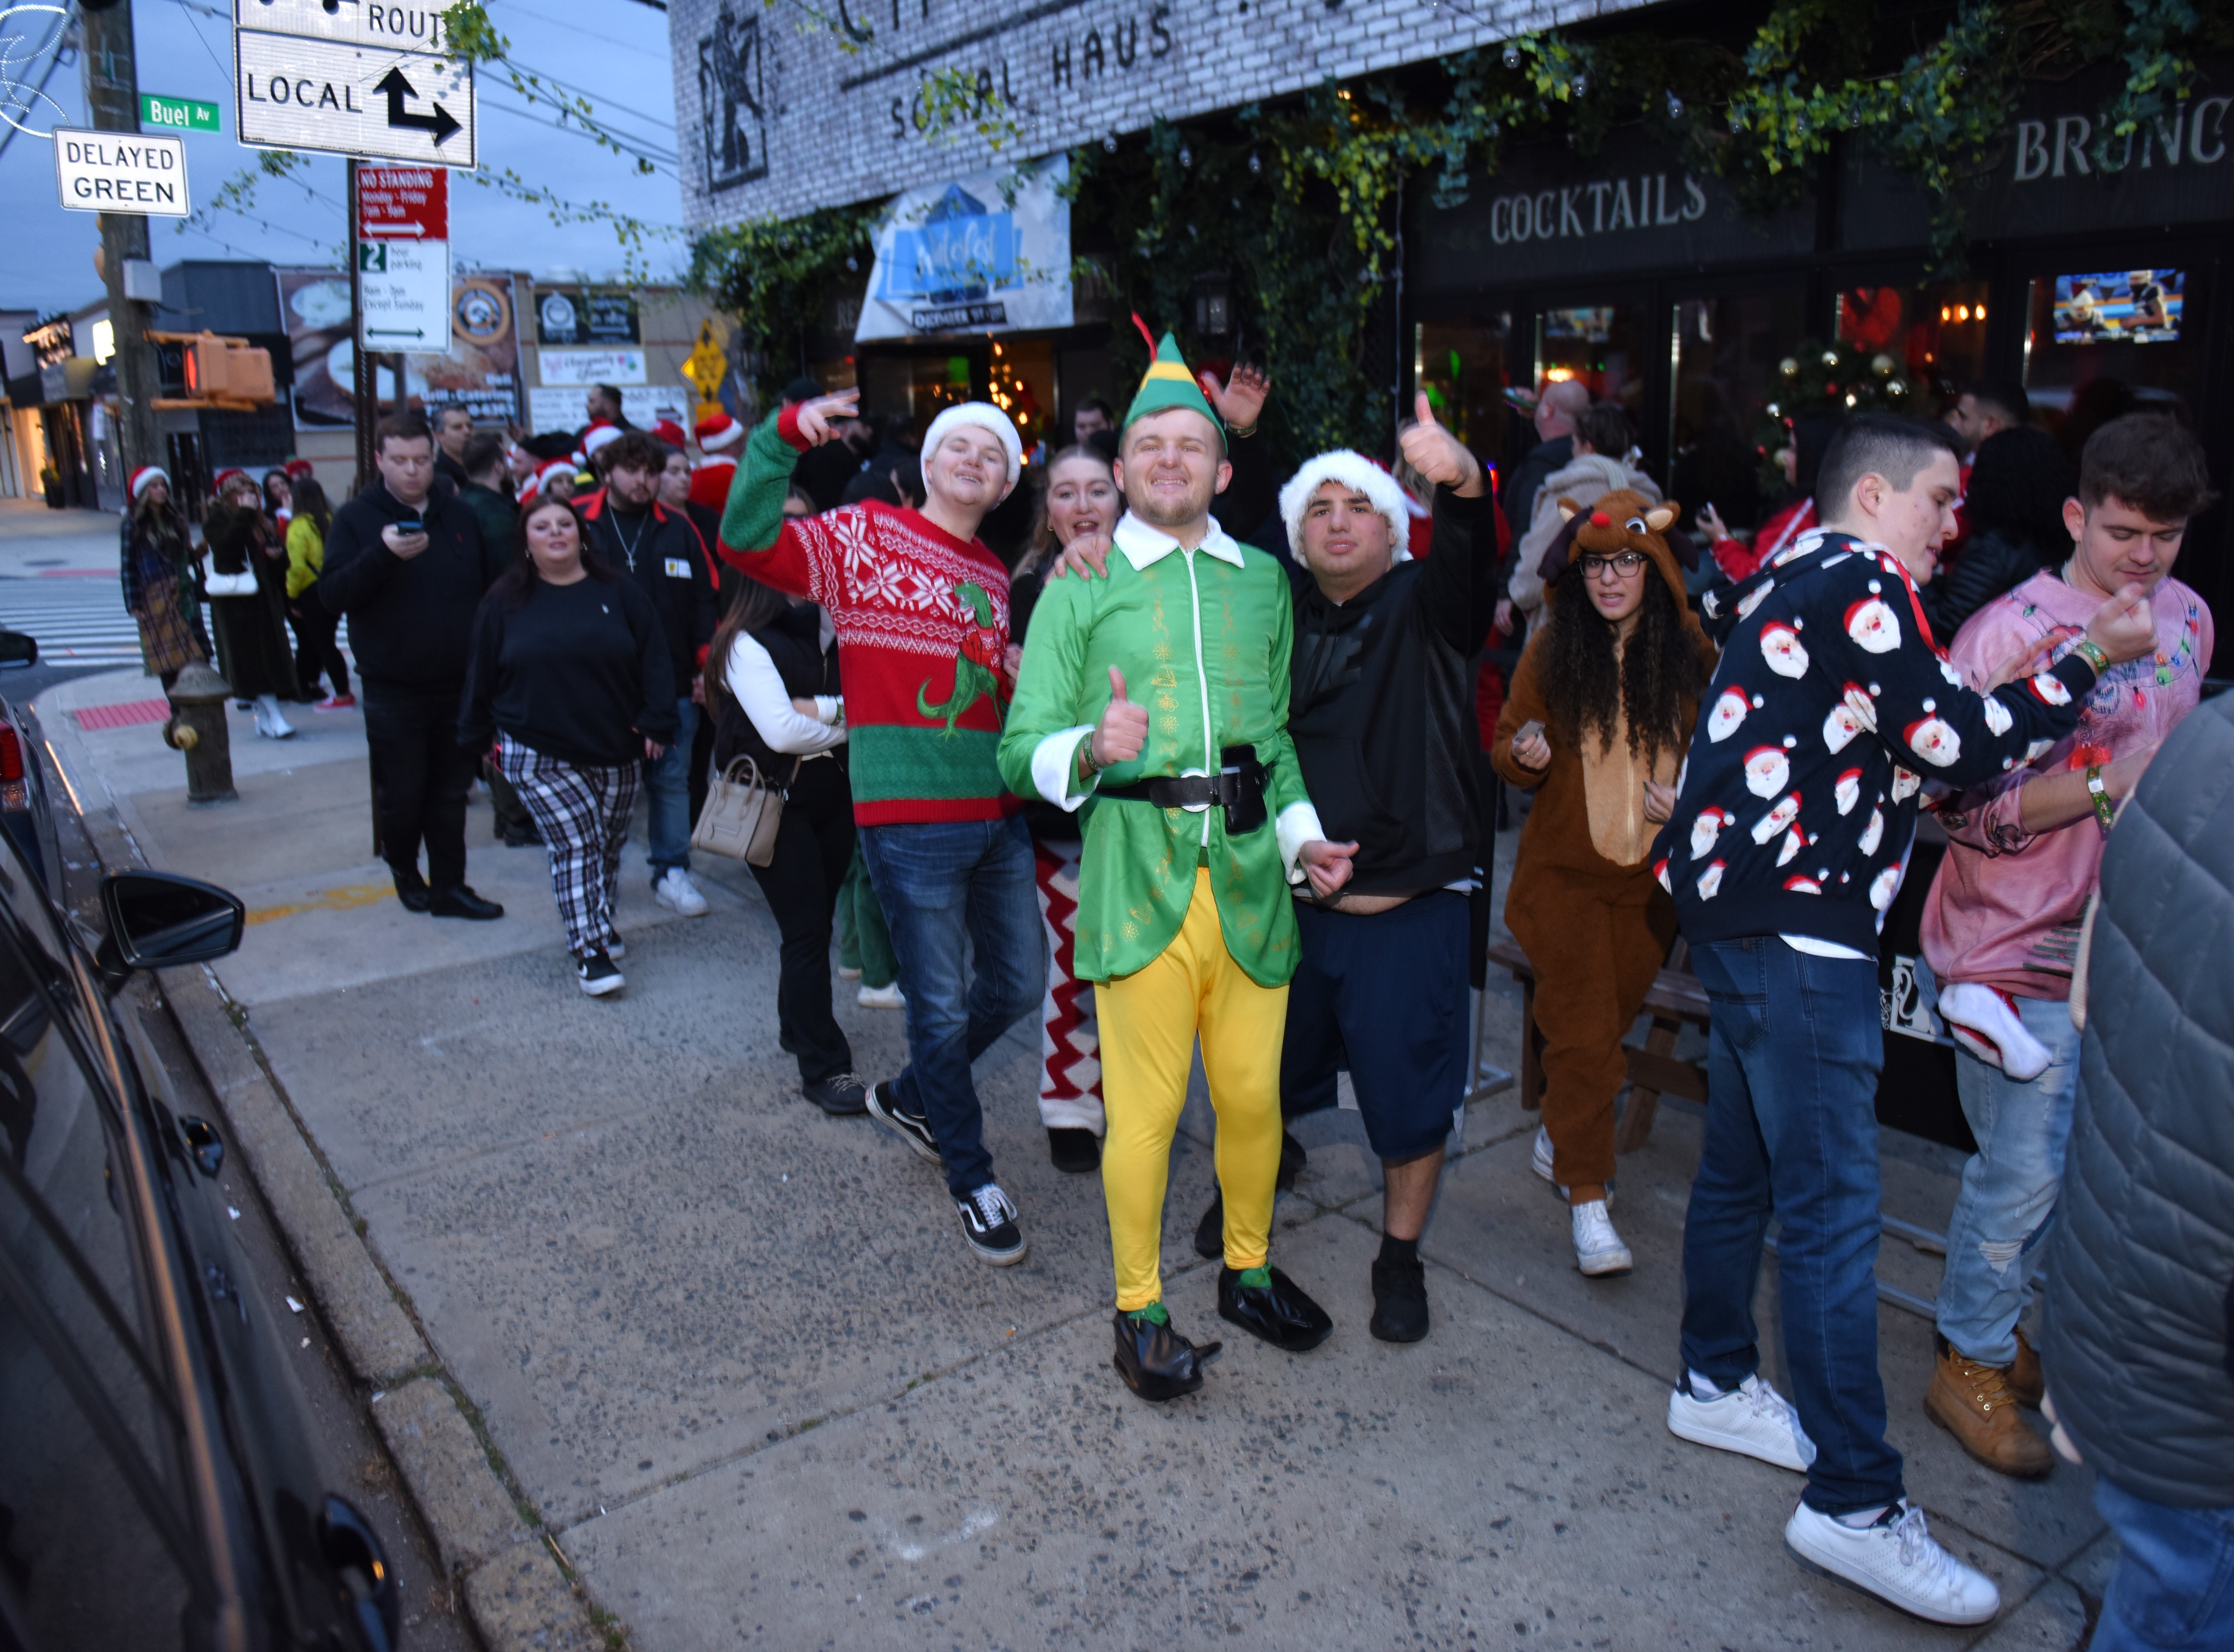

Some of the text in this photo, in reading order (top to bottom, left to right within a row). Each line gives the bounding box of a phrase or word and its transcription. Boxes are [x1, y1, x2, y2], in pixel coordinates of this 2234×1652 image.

[369, 4, 442, 40] ROUT
[891, 7, 1170, 139] SOAL HAUS
[248, 73, 363, 114] LOCAL
[150, 101, 209, 127] Buel Av
[2014, 97, 2234, 180] BRUNC
[67, 142, 173, 170] DELAYED
[75, 177, 174, 203] GREEN
[361, 171, 434, 189] NO STANDING
[361, 189, 393, 205] Monday
[400, 189, 427, 207] Friday
[1491, 173, 1706, 245] COCKTAILS
[366, 242, 381, 271] 2
[391, 247, 409, 258] hour
[391, 260, 422, 272] parking
[364, 298, 423, 312] Except Sunday
[456, 388, 514, 403] Catering
